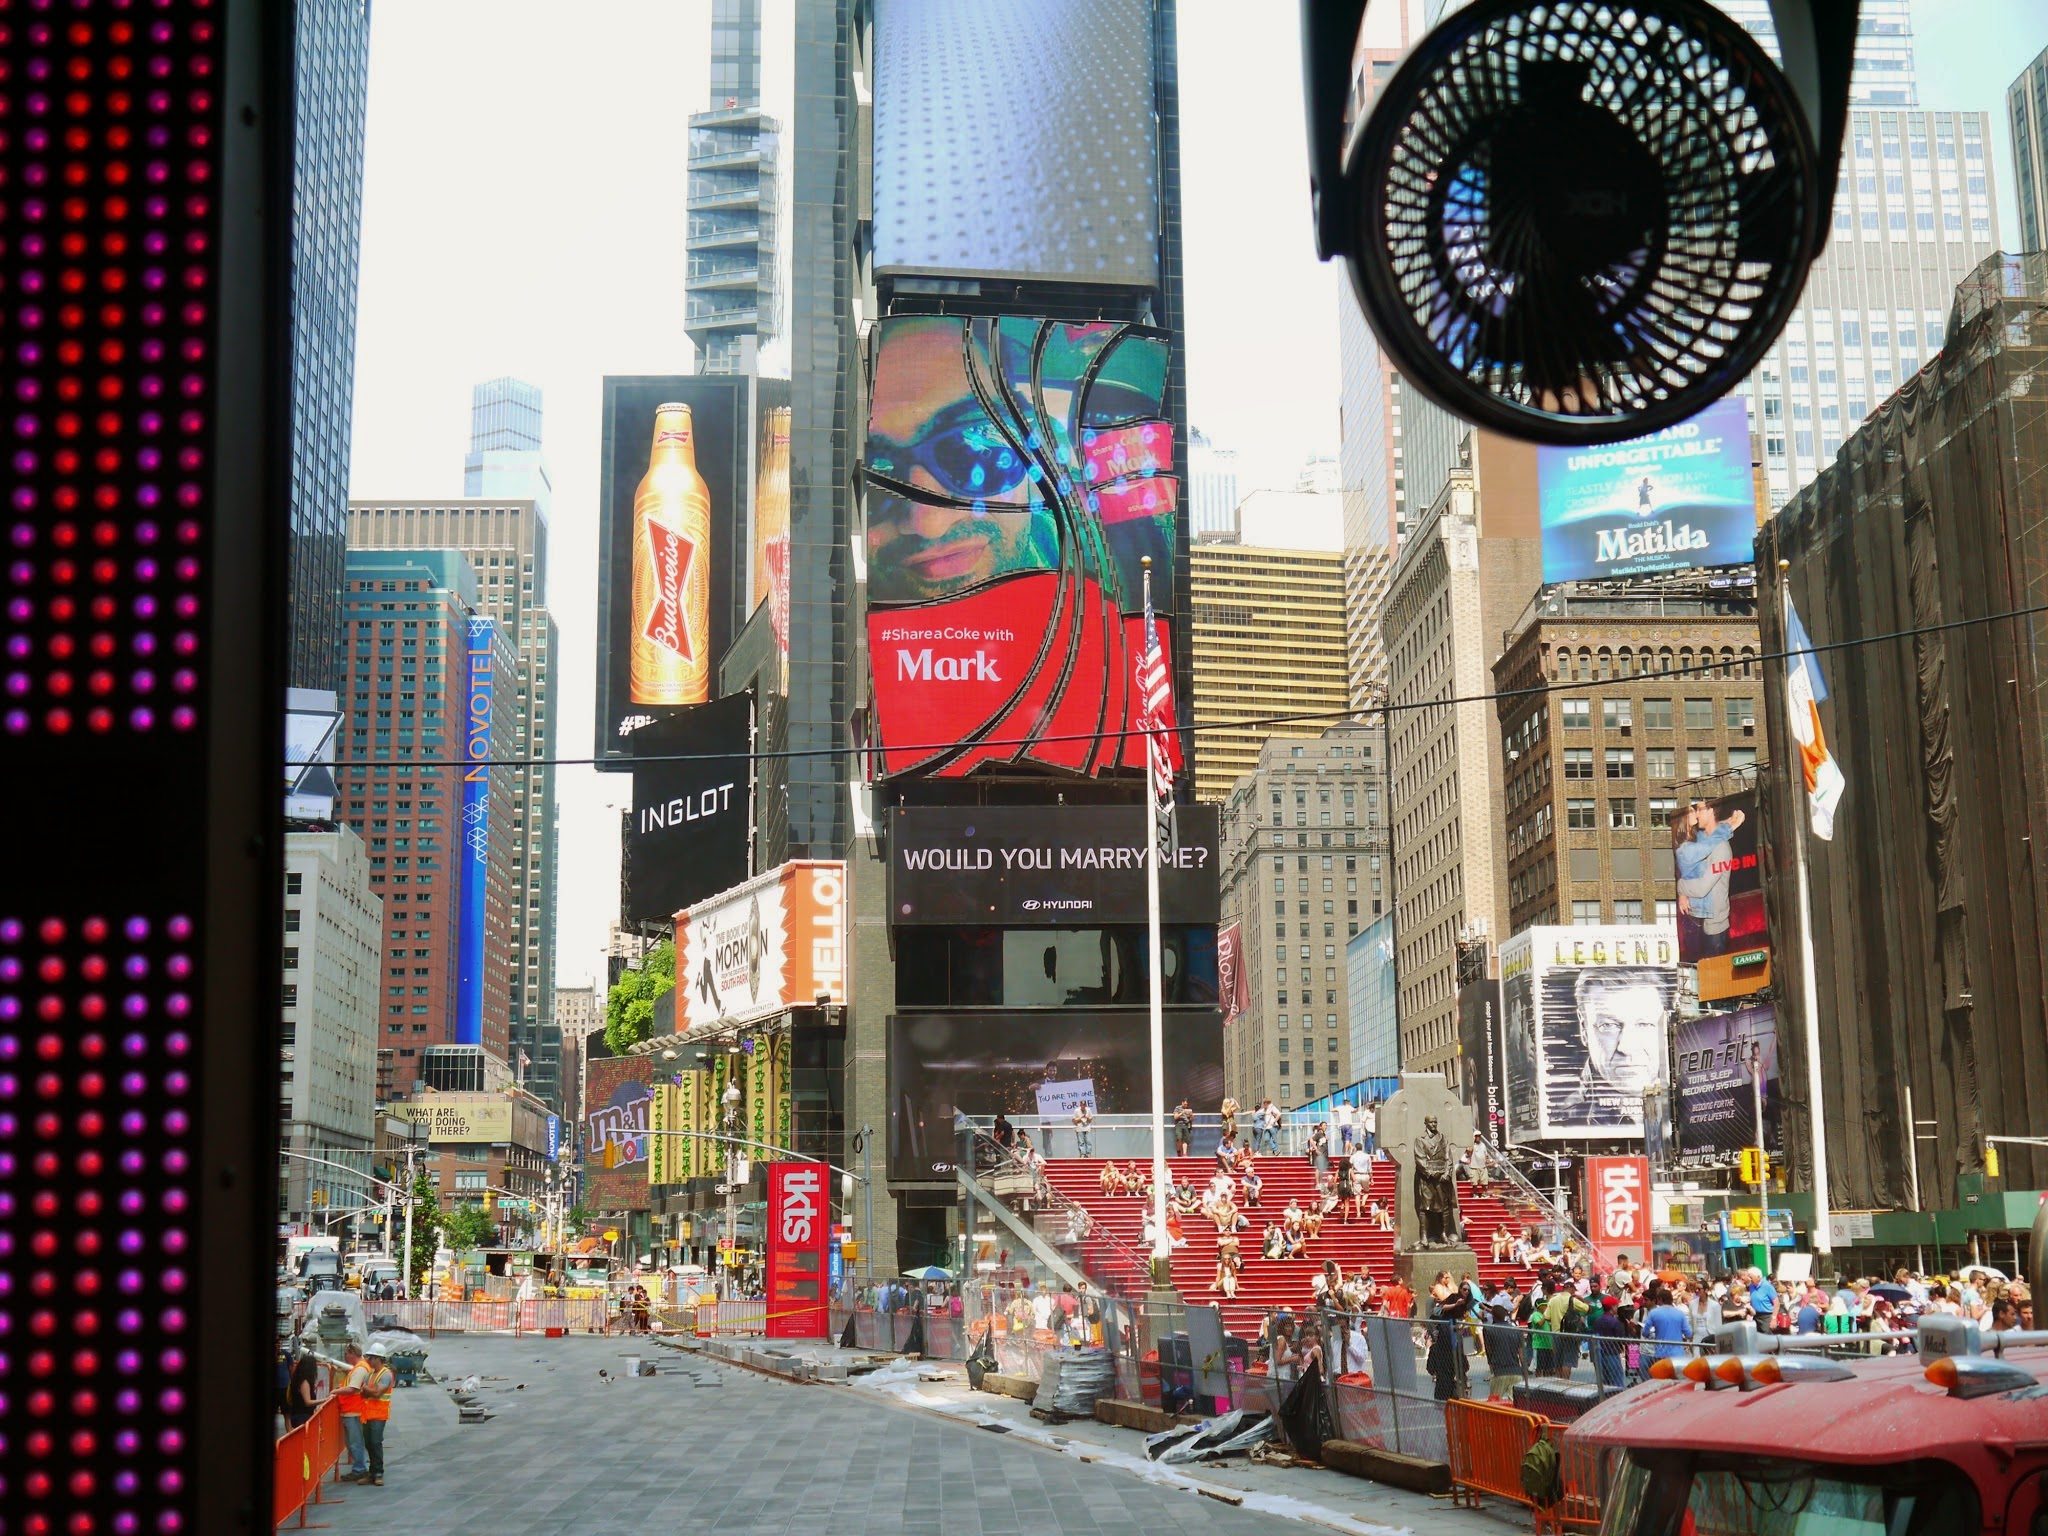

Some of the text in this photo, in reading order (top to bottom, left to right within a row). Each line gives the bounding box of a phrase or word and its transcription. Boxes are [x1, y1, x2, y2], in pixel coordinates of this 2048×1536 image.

[1595, 519, 1710, 563] Matilda
[1648, 553, 1671, 562] MUSICAL
[655, 526, 681, 652] Budweise
[983, 628, 1015, 641] with
[896, 648, 1002, 682] Mark
[464, 637, 493, 782] NOVOTEL
[641, 782, 734, 834] INGLOT
[903, 846, 1209, 870] WOULD YOU MARRY ME?
[1742, 854, 1757, 868] IN
[1043, 900, 1093, 909] HYUNDAI
[715, 921, 749, 946] THE BOOK OF
[812, 868, 842, 999] HELLO!
[1555, 941, 1671, 965] LEGEND
[1735, 954, 1762, 964] LAMAR
[754, 1041, 766, 1092] OLIVE
[1687, 1069, 1733, 1085] TOTAL SLEEP
[1682, 1078, 1743, 1097] RECOVERY SYSTEM
[406, 1108, 455, 1117] WHAT ARE
[1599, 1097, 1620, 1106] NEW
[435, 1117, 466, 1126] DOING
[1487, 1086, 1499, 1147] bideawee
[435, 1127, 471, 1136] THERE?
[783, 1170, 819, 1244] tkts
[1603, 1164, 1640, 1238] tkts
[1924, 1335, 1948, 1354] Mack
